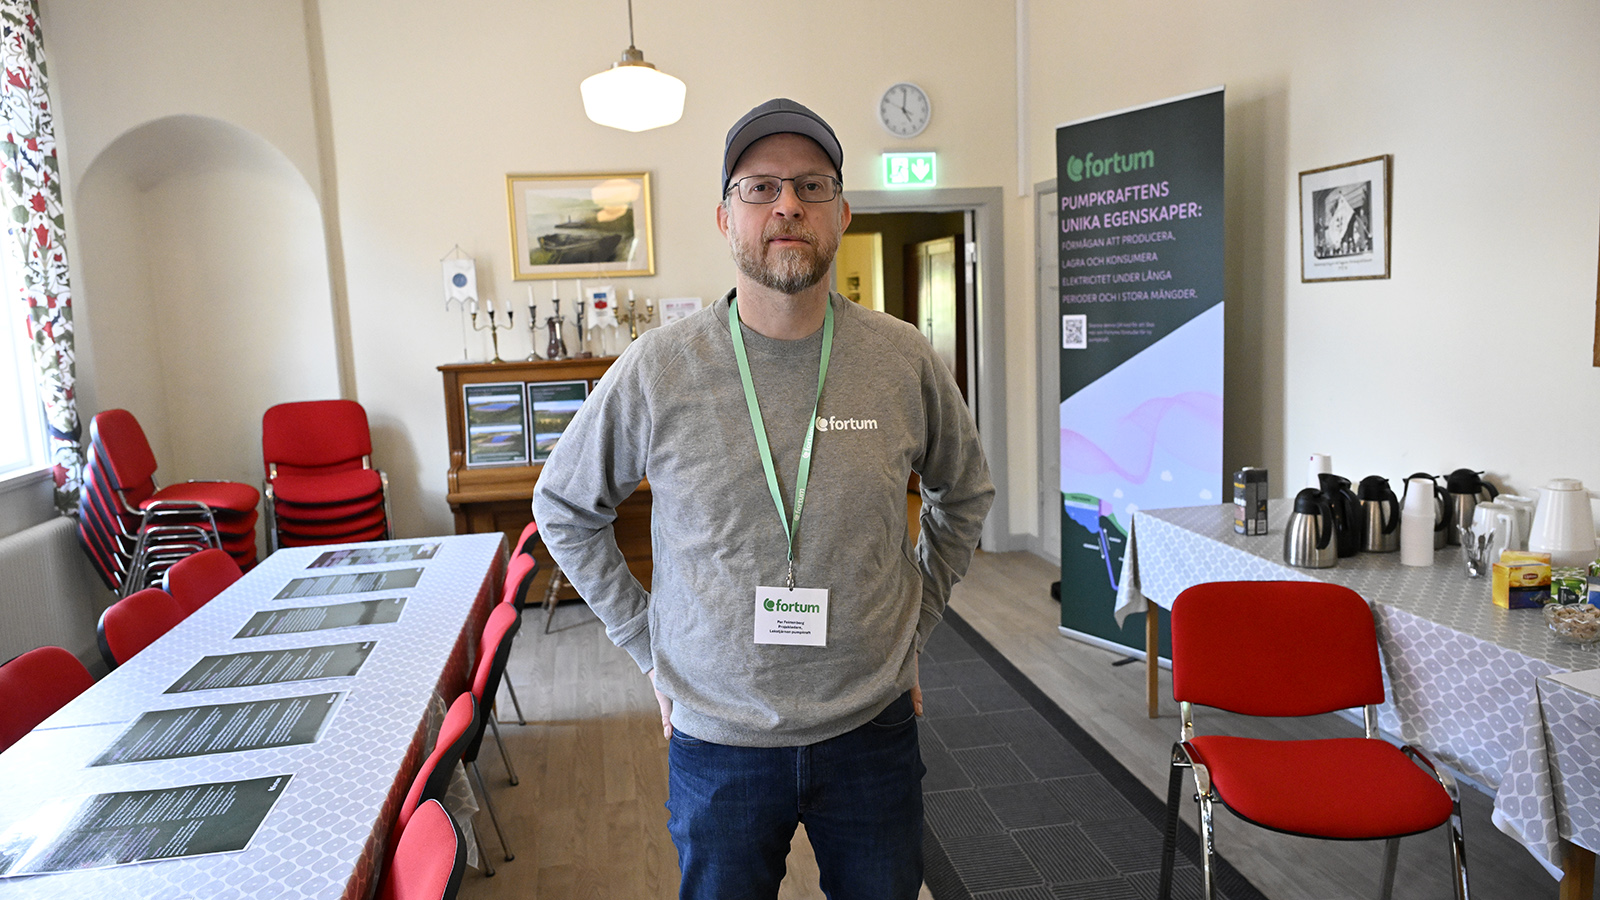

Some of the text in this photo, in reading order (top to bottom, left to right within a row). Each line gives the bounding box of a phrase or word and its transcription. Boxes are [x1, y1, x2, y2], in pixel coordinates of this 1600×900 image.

[1084, 149, 1155, 179] fortum
[1061, 181, 1170, 211] PUMPKRAFTENS
[1061, 202, 1203, 233] UNIKA EGENSKAPER:
[1061, 231, 1177, 251] FÖRMÅGAN ATT PRODUCERA,
[1061, 252, 1159, 269] LAGRA OCH KONSUMERA
[1061, 269, 1173, 286] ELEKTRICITET UNDER LÅNGA
[1061, 293, 1098, 304] PERIODER
[1098, 292, 1117, 303] OCH
[1122, 290, 1149, 302] STORA
[1150, 288, 1198, 300] MÄNGDER.
[829, 415, 878, 431] fortum
[805, 426, 814, 452] fortum
[795, 488, 806, 515] fortum
[776, 598, 820, 613] fortum
